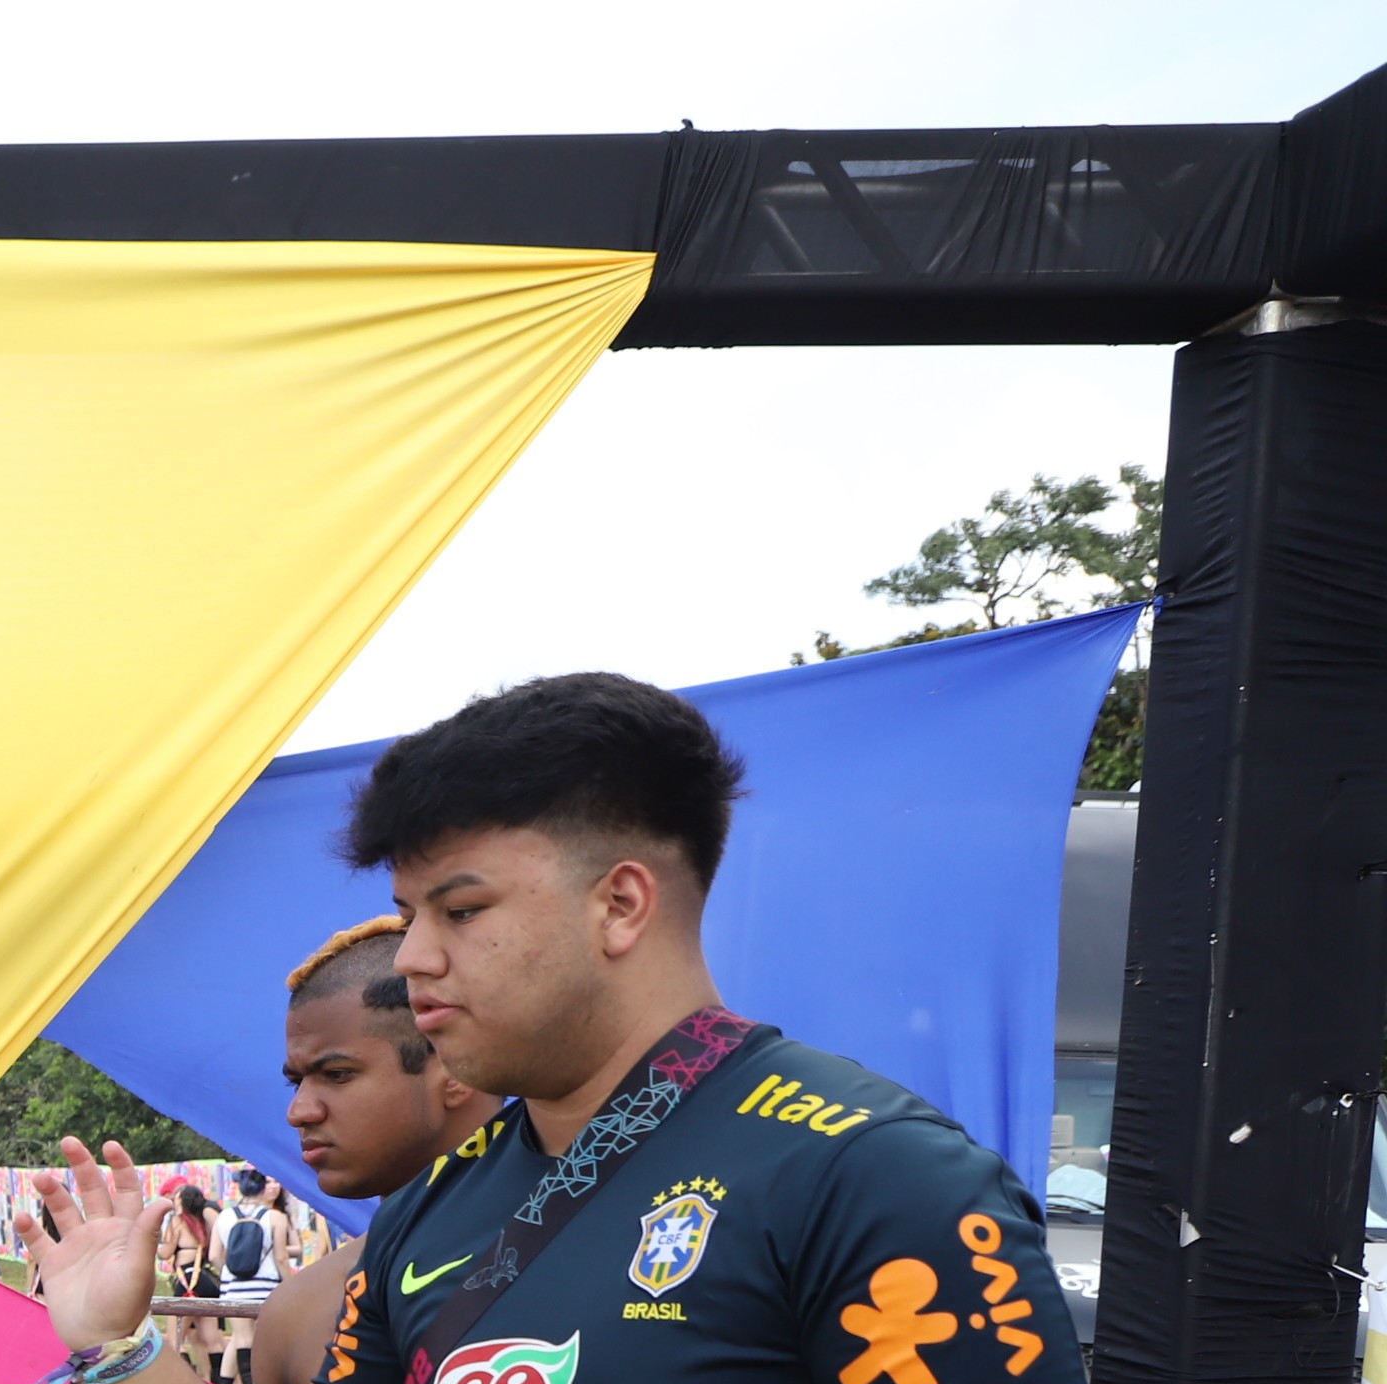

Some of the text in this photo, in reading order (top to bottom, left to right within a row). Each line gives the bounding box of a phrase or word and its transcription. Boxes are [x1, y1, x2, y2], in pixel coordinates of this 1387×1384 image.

[737, 1074, 874, 1136] Itaú
[657, 1232, 683, 1245] CBF
[622, 1302, 687, 1320] BRASIL
[958, 1213, 1045, 1377] vivo
